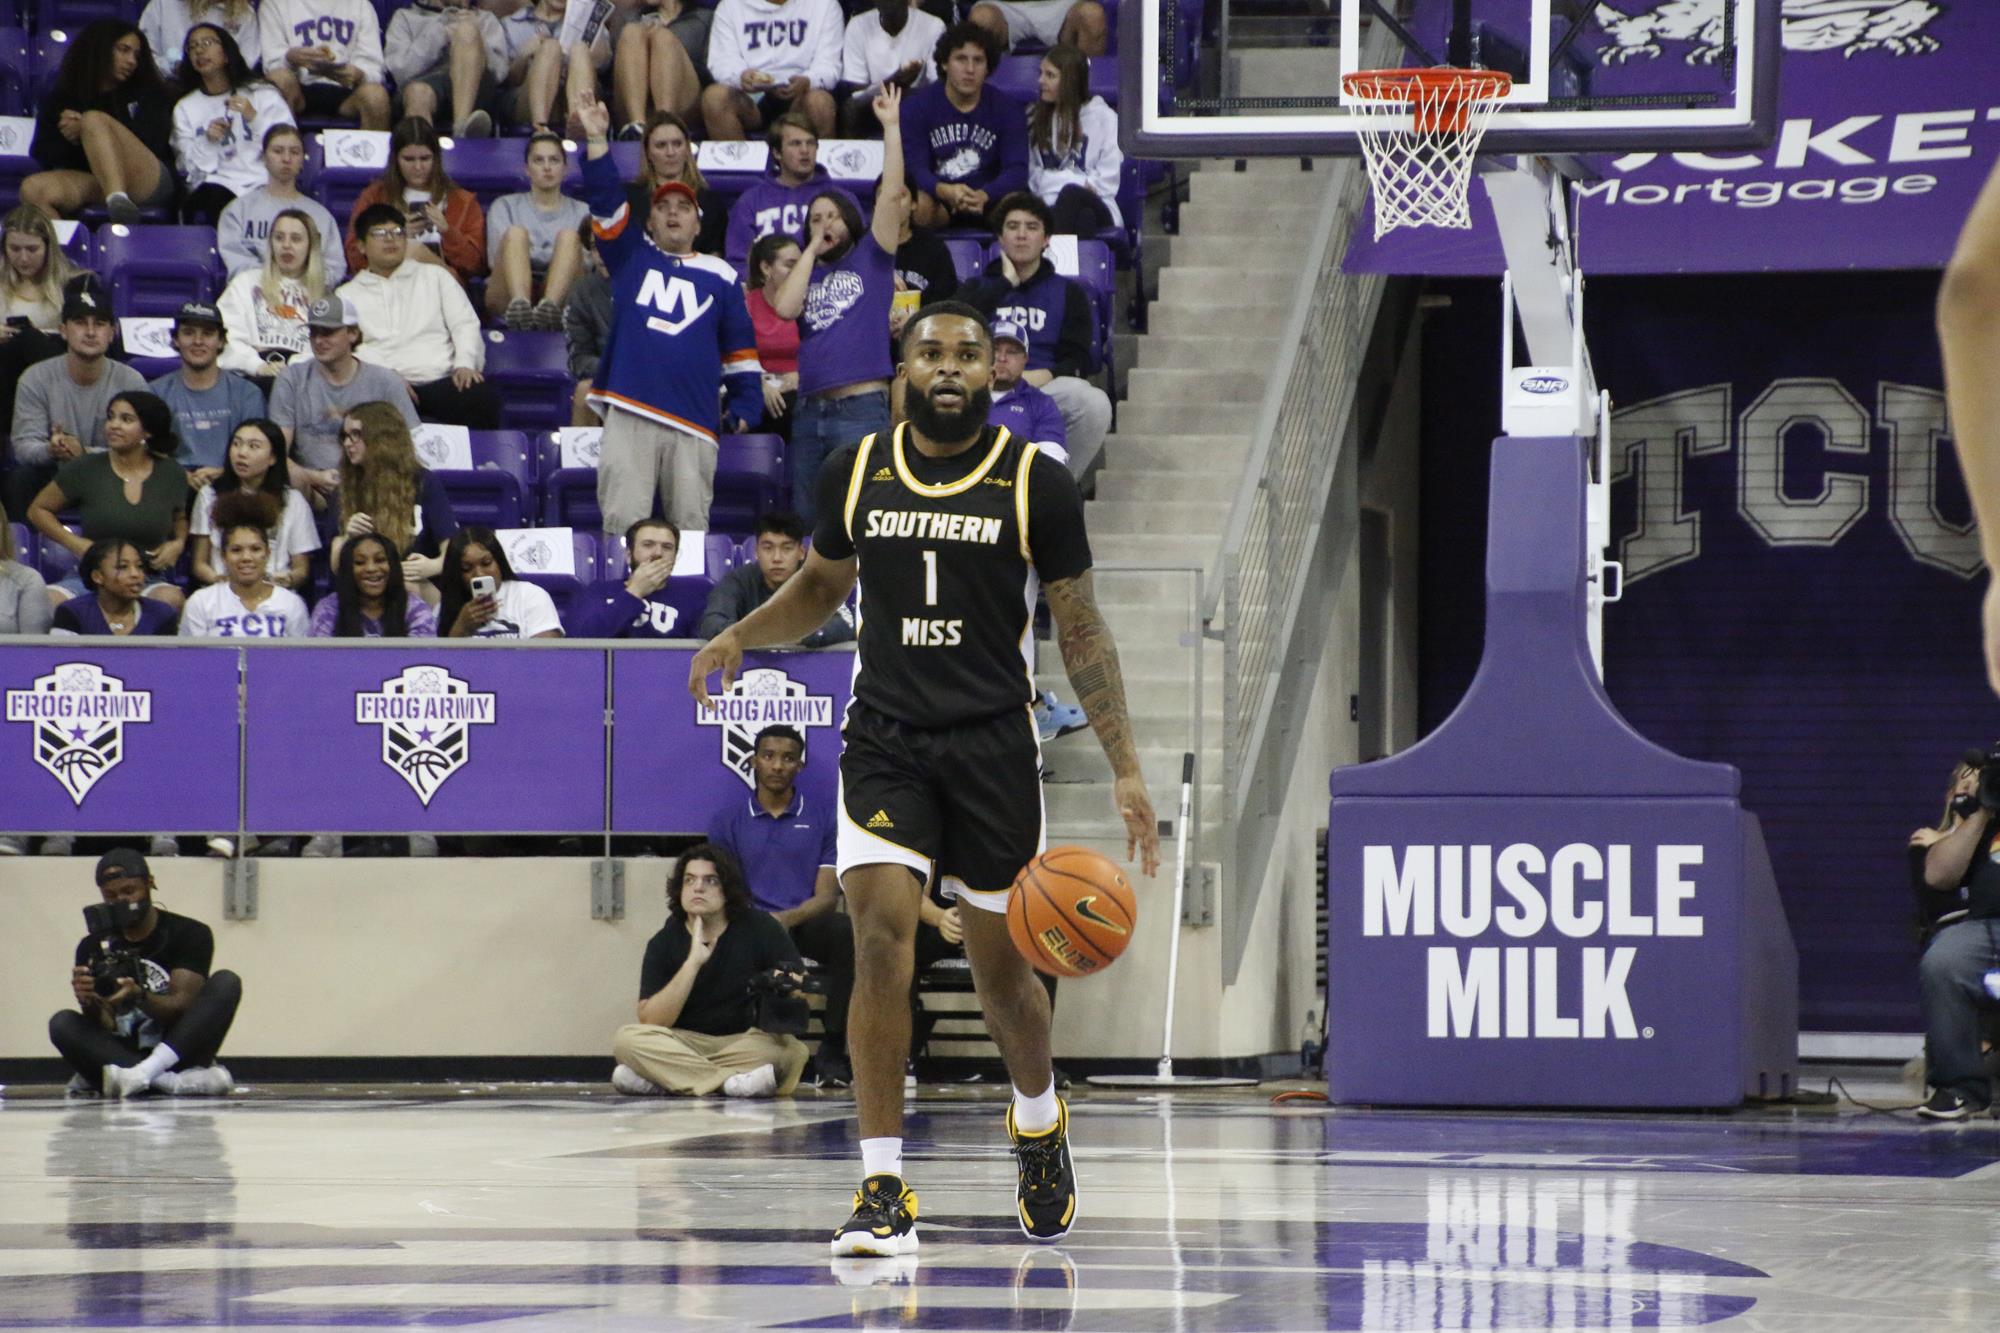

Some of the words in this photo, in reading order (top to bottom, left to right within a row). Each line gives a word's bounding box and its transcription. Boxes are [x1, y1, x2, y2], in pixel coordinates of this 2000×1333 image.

[294, 15, 355, 47] TCU
[744, 17, 808, 51] TCU
[1572, 174, 1938, 208] Mortgage
[635, 268, 714, 336] NY
[996, 306, 1048, 332] TCU
[865, 509, 1003, 545] SOUTHERN
[922, 550, 938, 606] 1
[215, 612, 287, 638] TCU
[901, 617, 963, 646] MISS
[11, 694, 73, 717] FROG
[77, 694, 145, 718] ARMY
[361, 697, 420, 719] FROG
[424, 697, 490, 719] ARMY
[763, 699, 828, 722] ARMY
[1363, 842, 1704, 938] MUSCLE
[1427, 946, 1639, 1039] MILK
